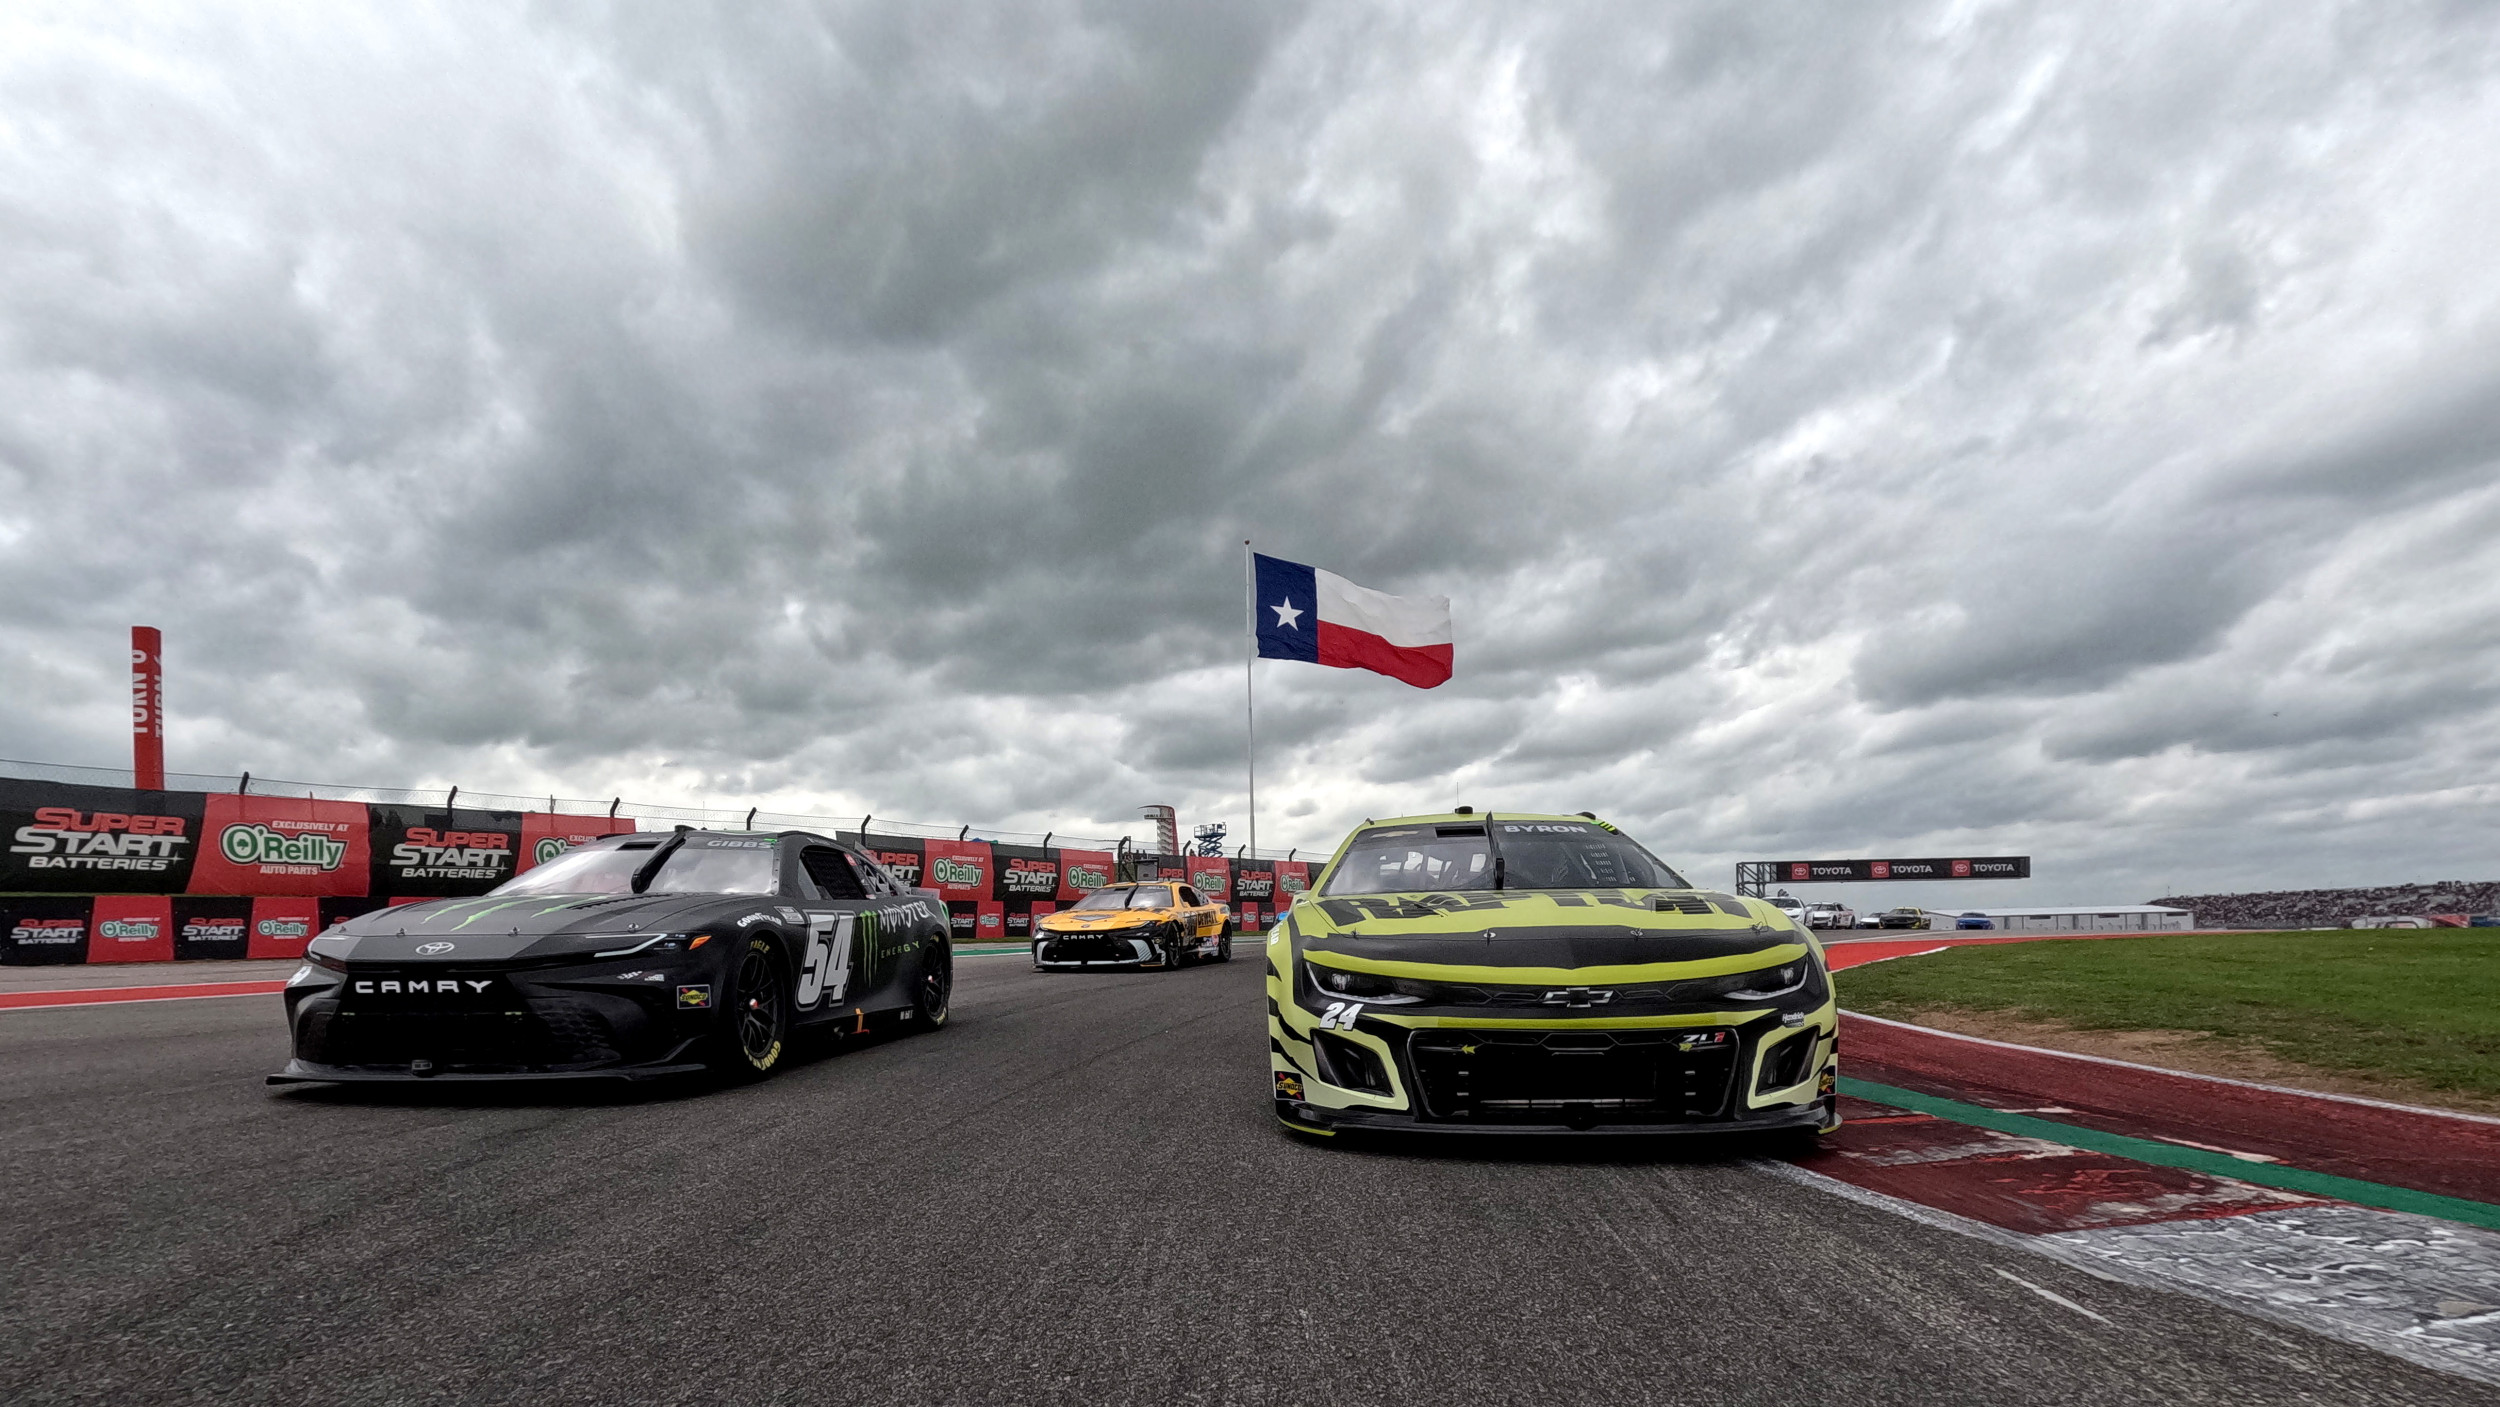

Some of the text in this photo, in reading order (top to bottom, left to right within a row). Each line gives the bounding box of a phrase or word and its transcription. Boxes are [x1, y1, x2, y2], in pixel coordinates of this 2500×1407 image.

[32, 806, 186, 836] SUPER
[271, 820, 349, 832] EXCLUSIVELY AT
[1504, 825, 1588, 834] BYRON
[9, 826, 187, 857] START
[404, 826, 509, 849] SUPER
[224, 826, 343, 868] O'Reilly
[707, 840, 773, 849] GIBBS
[389, 843, 511, 867] START
[28, 856, 169, 871] BATTERIES
[1010, 858, 1056, 872] SUPER
[1892, 864, 1933, 874] TOYOTA
[1973, 862, 2015, 872] TOYOTA
[259, 865, 318, 876] AUTO PARTS
[401, 867, 498, 879] BATTERIES
[934, 859, 982, 886] O'Reilly
[1003, 869, 1057, 884] START
[1158, 868, 1184, 878] UPER
[1240, 869, 1273, 880] SUPER
[1811, 866, 1852, 875] TOYOTA
[1008, 884, 1051, 892] BATTERIES
[1236, 878, 1273, 890] START
[19, 918, 84, 928] SUPER
[189, 917, 244, 926] SUPER
[878, 901, 937, 934] MONSTER
[10, 926, 85, 939] START
[101, 921, 158, 938] O'Reilly
[182, 925, 246, 936] START
[258, 920, 308, 936] O'Reilly
[881, 940, 920, 959] ENERGY
[797, 911, 856, 1008] 54
[355, 980, 493, 994] CAMRY
[1319, 1002, 1365, 1031] 24
[1683, 1031, 1726, 1044] ZL1
[1277, 1081, 1303, 1092] SUNOCO
